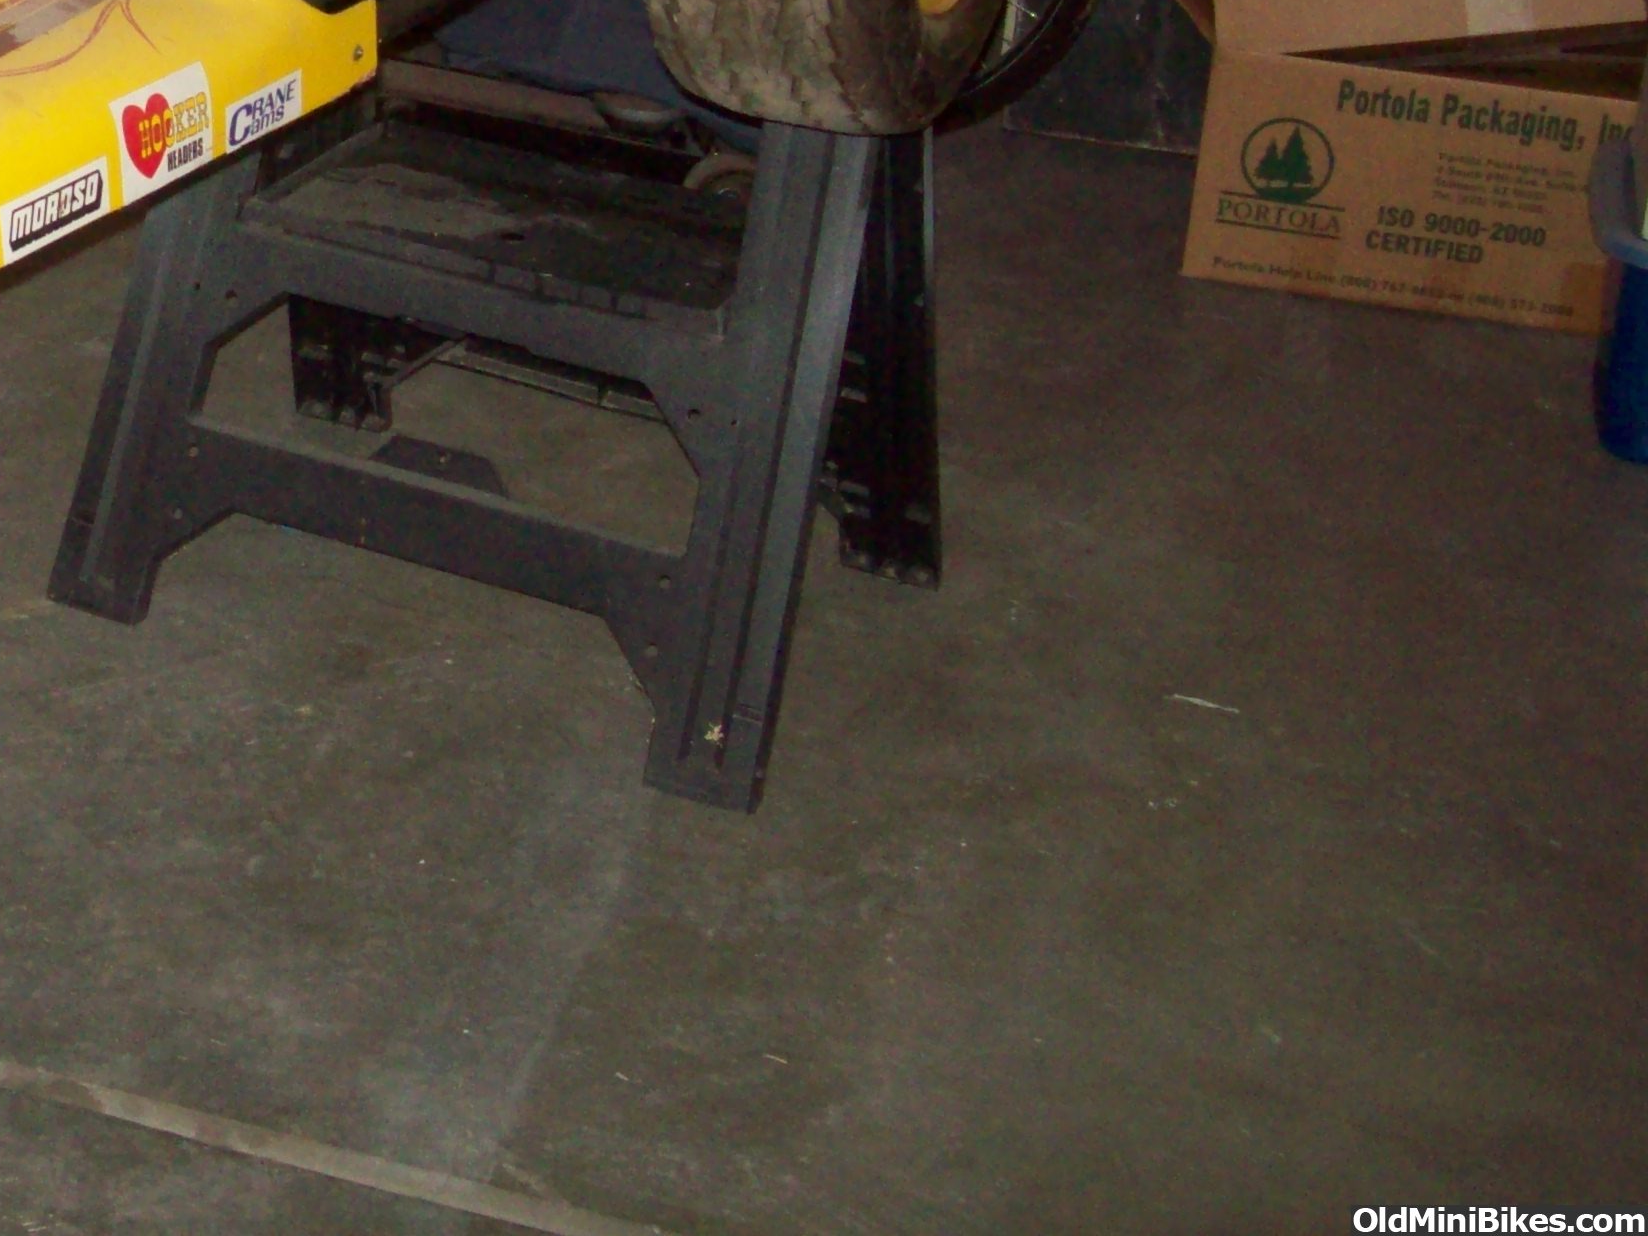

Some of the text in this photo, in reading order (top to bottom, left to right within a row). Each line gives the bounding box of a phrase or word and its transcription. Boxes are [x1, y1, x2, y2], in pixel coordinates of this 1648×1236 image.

[139, 92, 210, 159] HOOKER
[1337, 78, 1430, 125] Portola
[1440, 94, 1586, 151] Packaging,
[167, 137, 203, 172] HEADERS
[9, 169, 102, 251] MOROSO
[1218, 197, 1342, 235] PORTOLA
[1377, 205, 1547, 248] ISO 9000-2000
[1365, 230, 1484, 264] CERTIFIED
